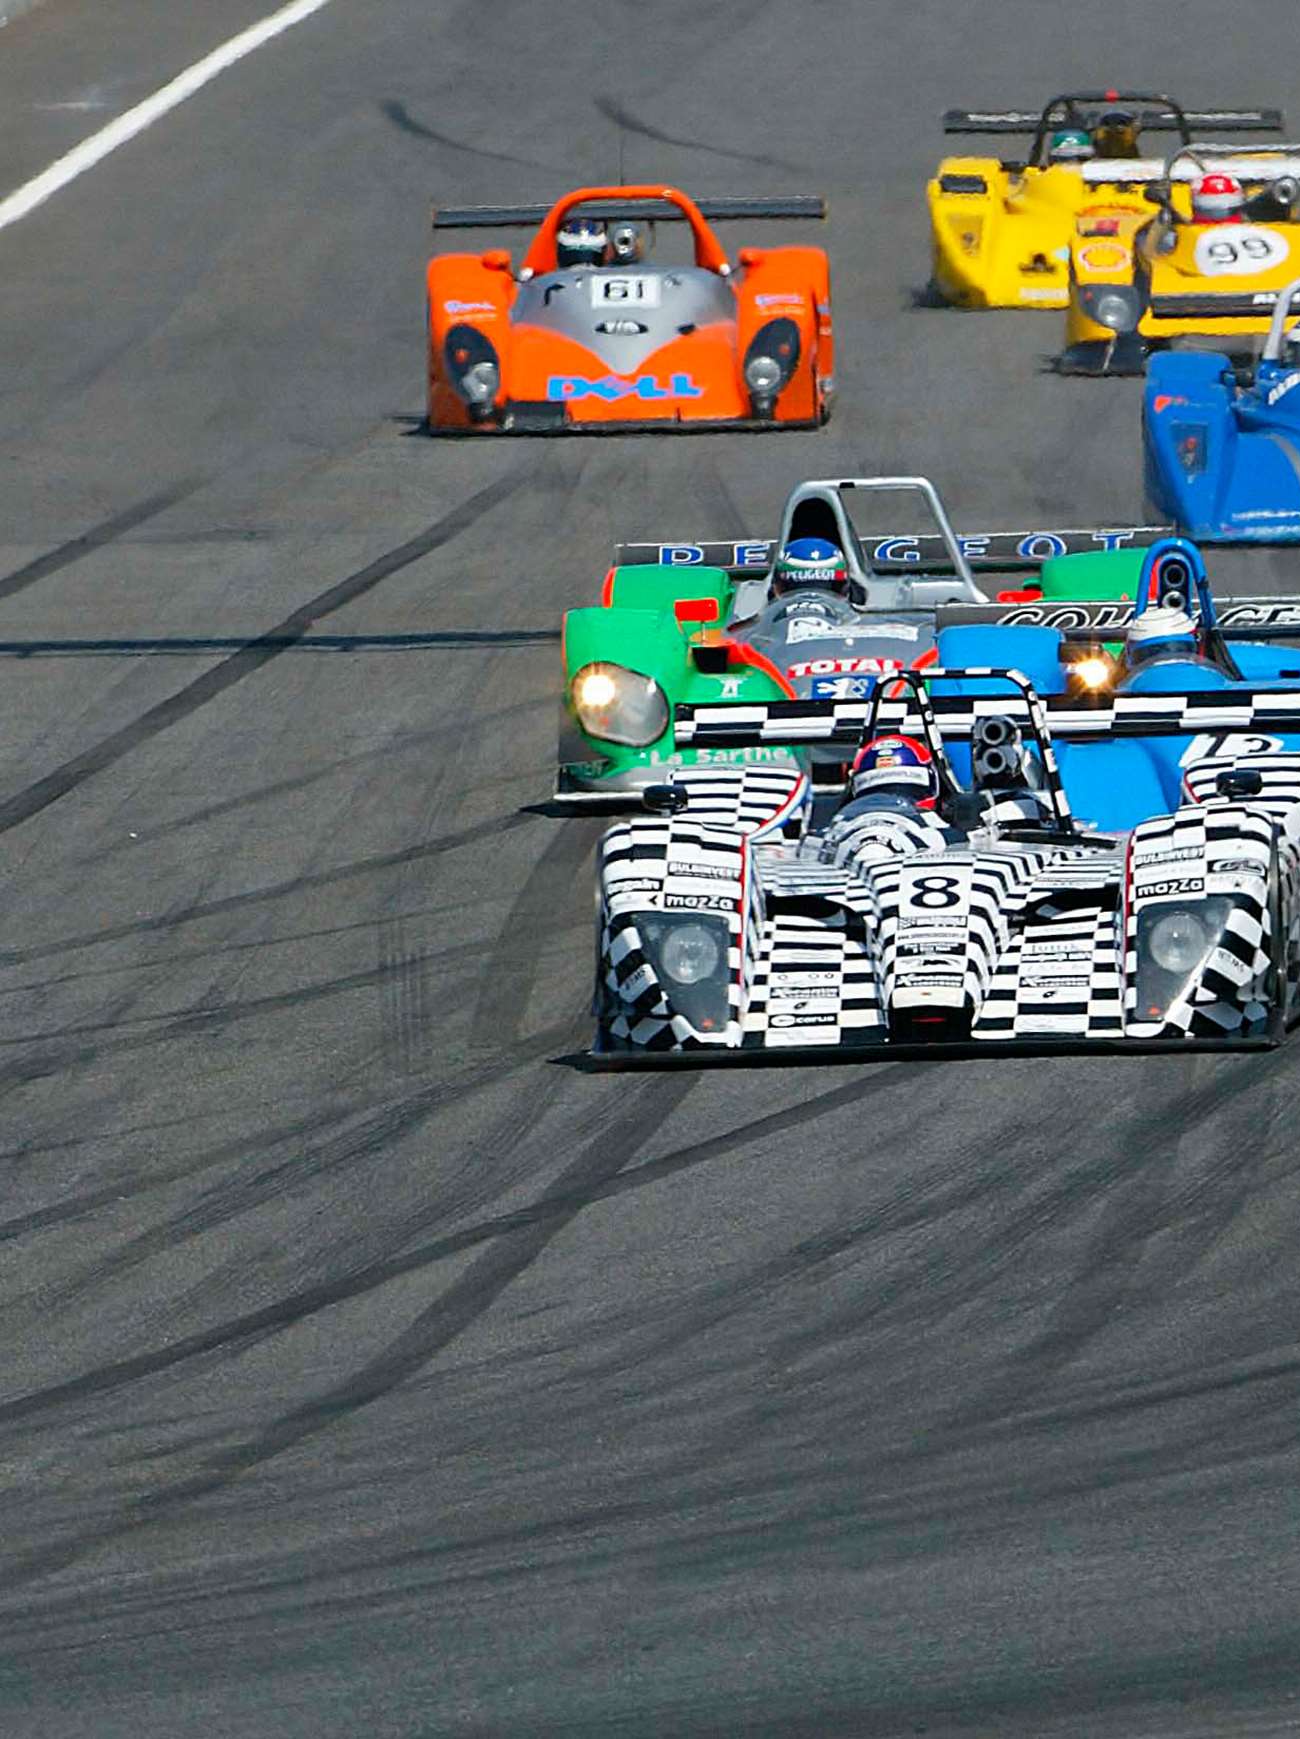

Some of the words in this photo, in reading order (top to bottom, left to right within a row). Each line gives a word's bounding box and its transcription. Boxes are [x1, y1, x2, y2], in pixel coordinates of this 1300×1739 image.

[1207, 237, 1271, 264] 99
[603, 280, 645, 299] 61
[658, 532, 1135, 567] PEGEOT
[790, 657, 898, 679] TOTAL
[651, 750, 683, 765] La
[696, 746, 789, 764] Sarthe
[910, 876, 961, 909] 8
